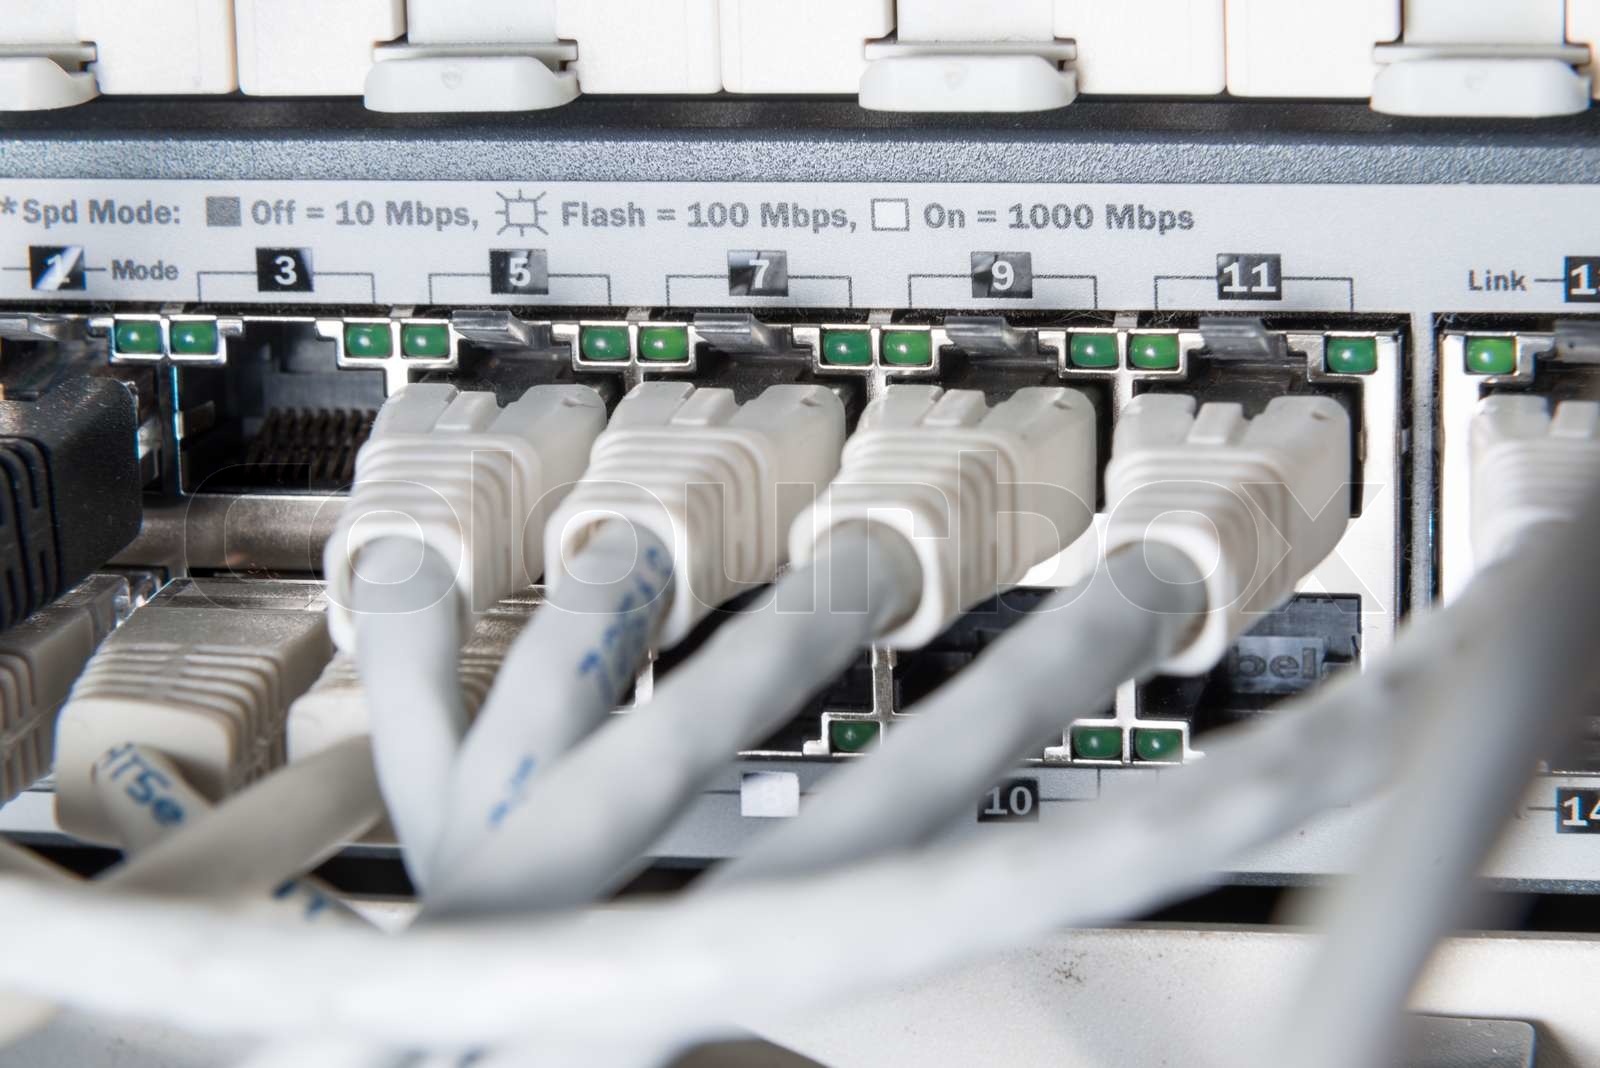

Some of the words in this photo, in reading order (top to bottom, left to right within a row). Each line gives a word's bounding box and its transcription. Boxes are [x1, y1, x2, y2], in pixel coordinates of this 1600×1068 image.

[89, 200, 181, 224] Mode:
[251, 200, 296, 225] Off
[335, 201, 375, 225] 10
[386, 201, 479, 231] Mbps,
[562, 202, 646, 227] Flash
[687, 202, 750, 228] 100
[760, 203, 857, 233] Mbps,
[924, 203, 966, 229] On
[1008, 203, 1094, 230] 1000
[1105, 204, 1195, 235] Mbps
[112, 259, 178, 280] Mode
[274, 255, 297, 285] 3
[509, 257, 531, 287] 5
[750, 259, 770, 289] 7
[991, 260, 1015, 291] 9
[1222, 262, 1277, 293] 11
[1468, 270, 1527, 291] Link
[1571, 264, 1600, 295] 1
[1231, 645, 1317, 680] bel
[983, 787, 1033, 815] 10
